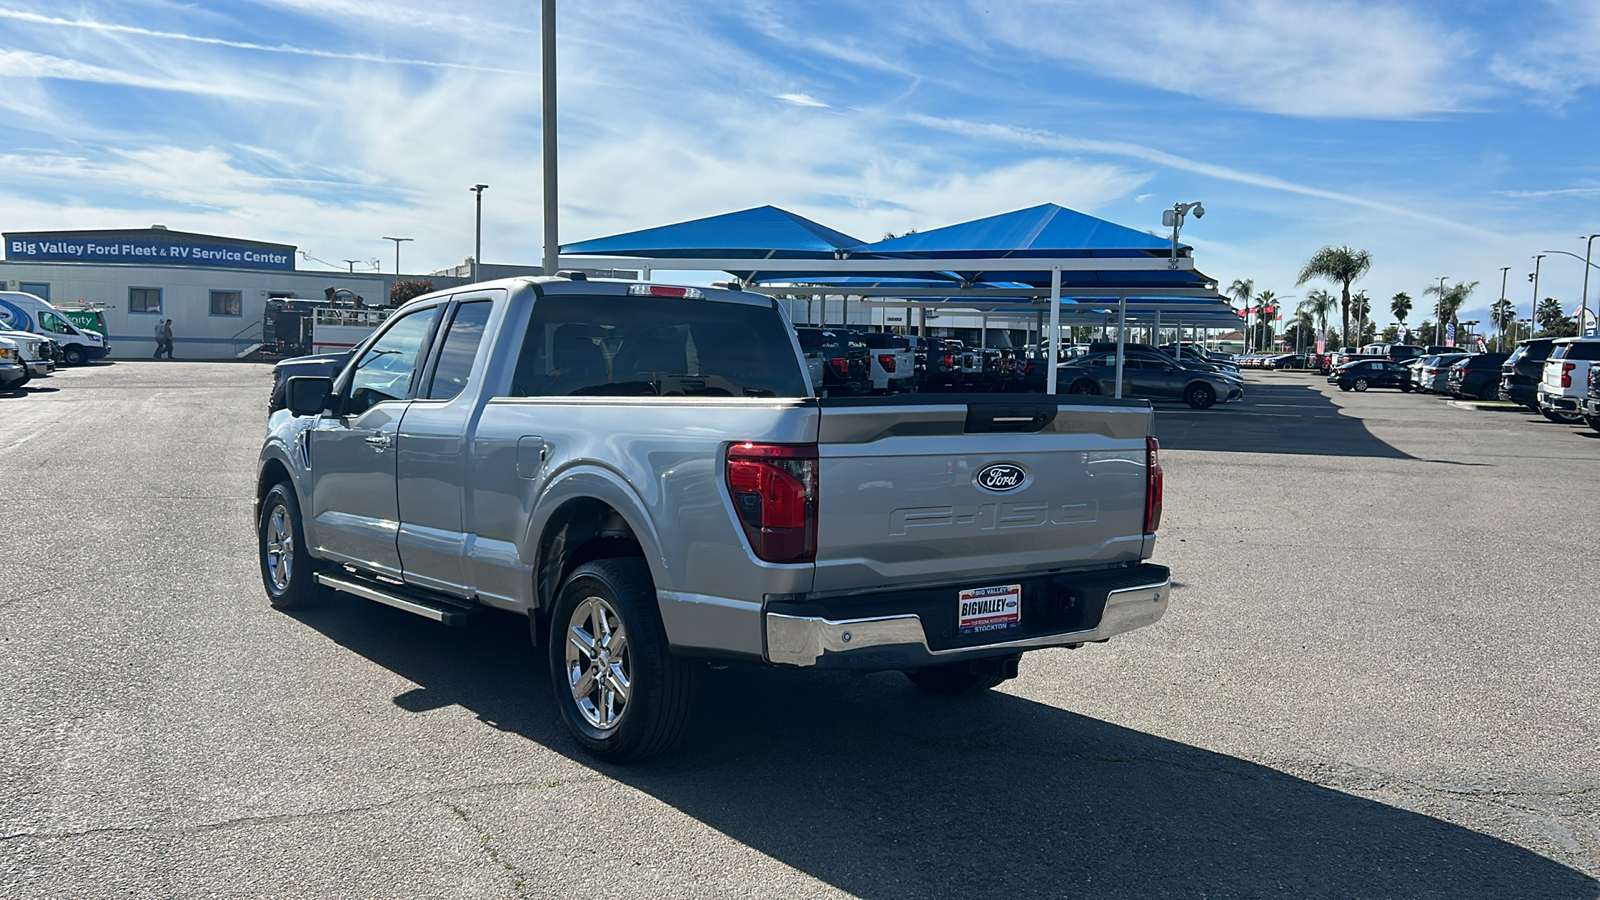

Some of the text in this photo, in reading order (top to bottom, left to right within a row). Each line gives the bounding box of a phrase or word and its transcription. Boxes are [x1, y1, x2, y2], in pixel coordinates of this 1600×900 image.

[12, 241, 287, 264] Big Valley Ford Fleet & RV Service Center
[986, 468, 1018, 486] Ford
[888, 500, 1099, 536] F-150
[974, 622, 1008, 632] STOCKTON
